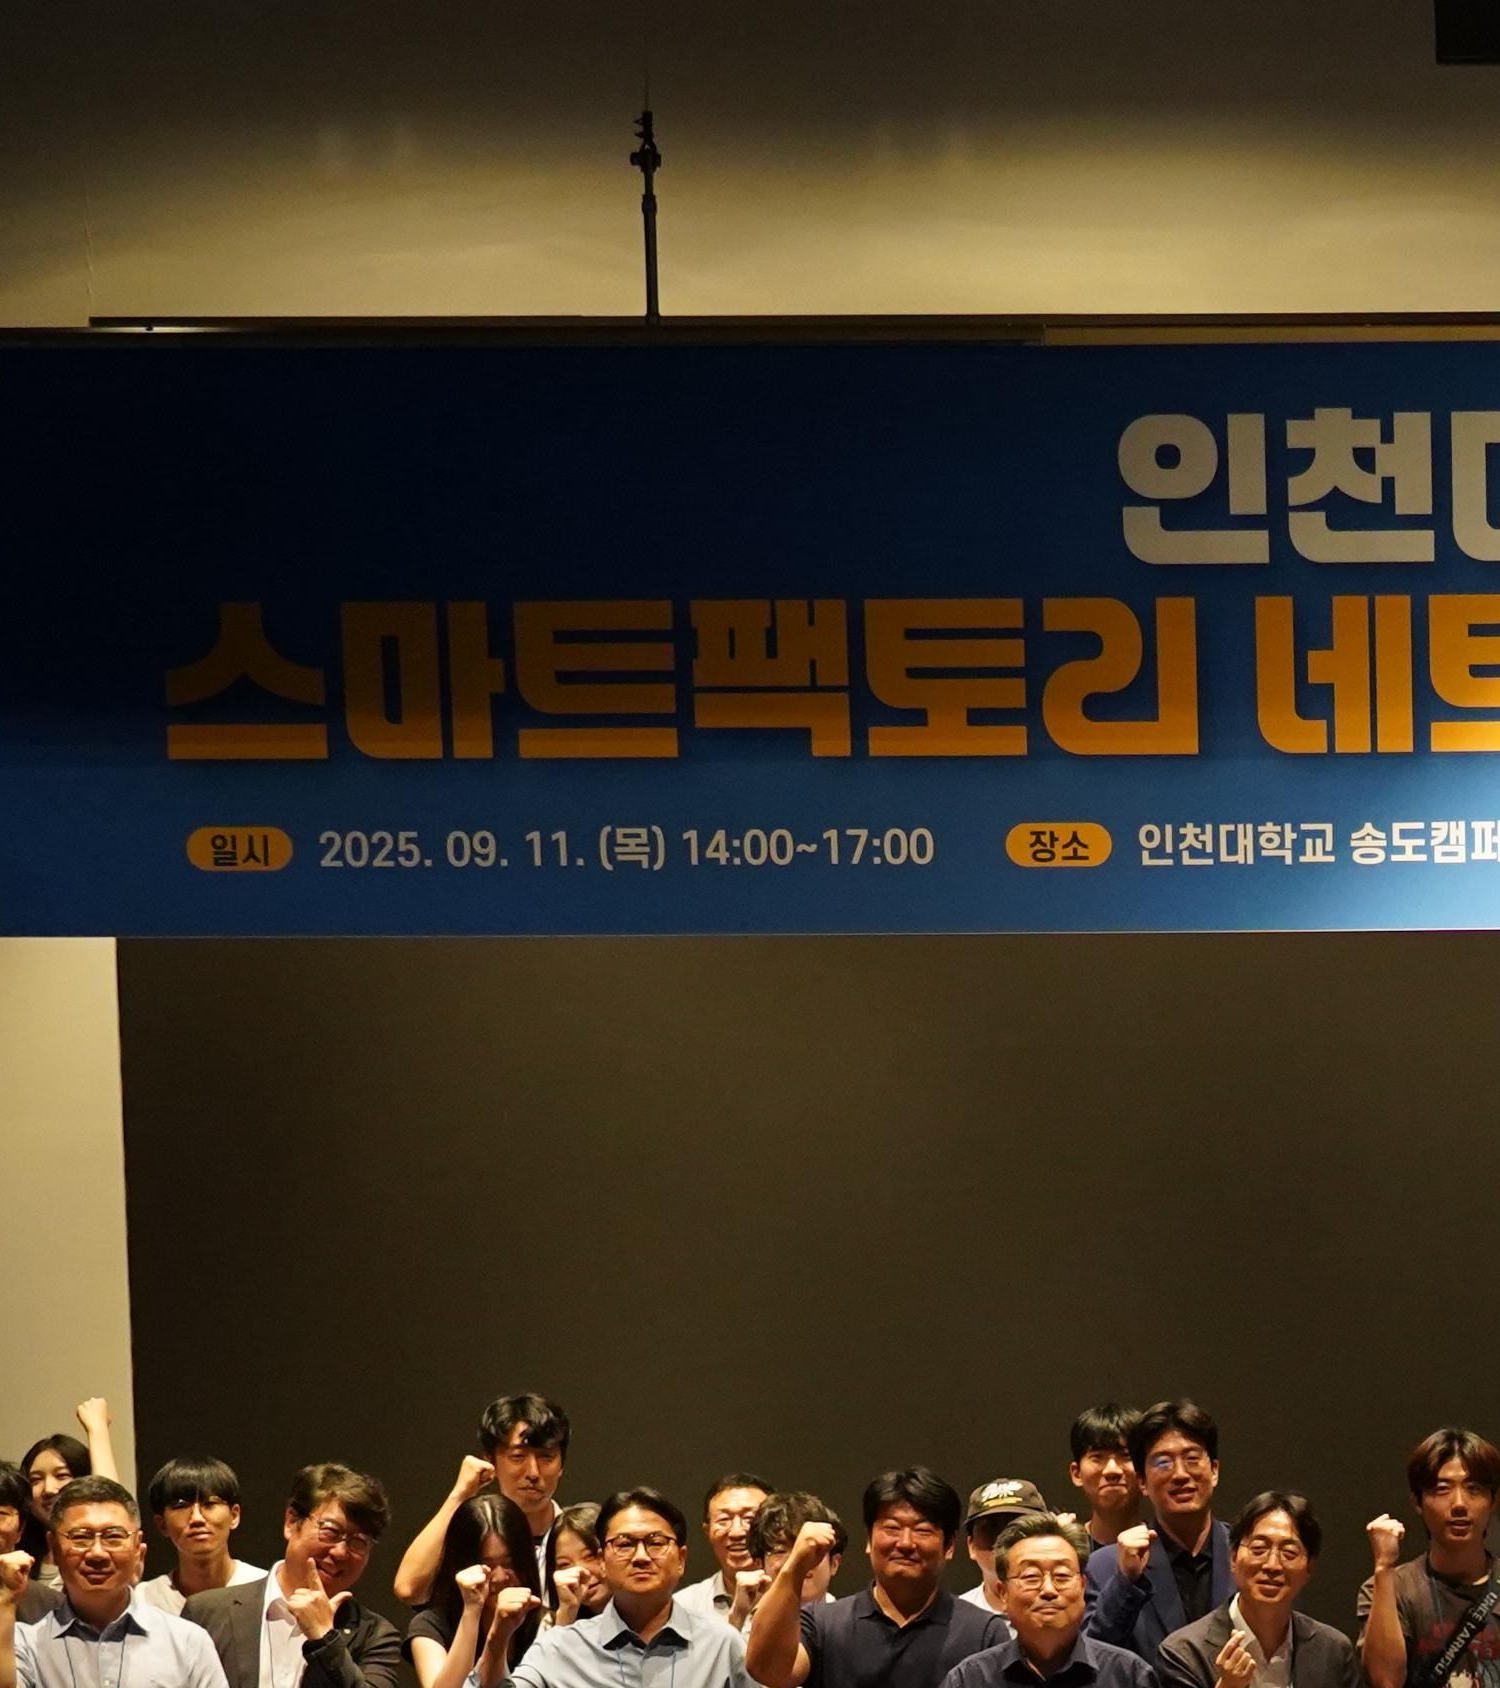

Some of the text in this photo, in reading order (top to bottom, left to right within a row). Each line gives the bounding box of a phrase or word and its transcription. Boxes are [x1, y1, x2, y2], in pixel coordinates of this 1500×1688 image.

[165, 595, 1200, 760] 스마트팩토리
[211, 832, 271, 868] 일시
[320, 825, 935, 870] 2025. 09. 11. (목) 14:00~17:00
[1030, 829, 1090, 862] 장소
[1139, 821, 1337, 866] 인천대학교
